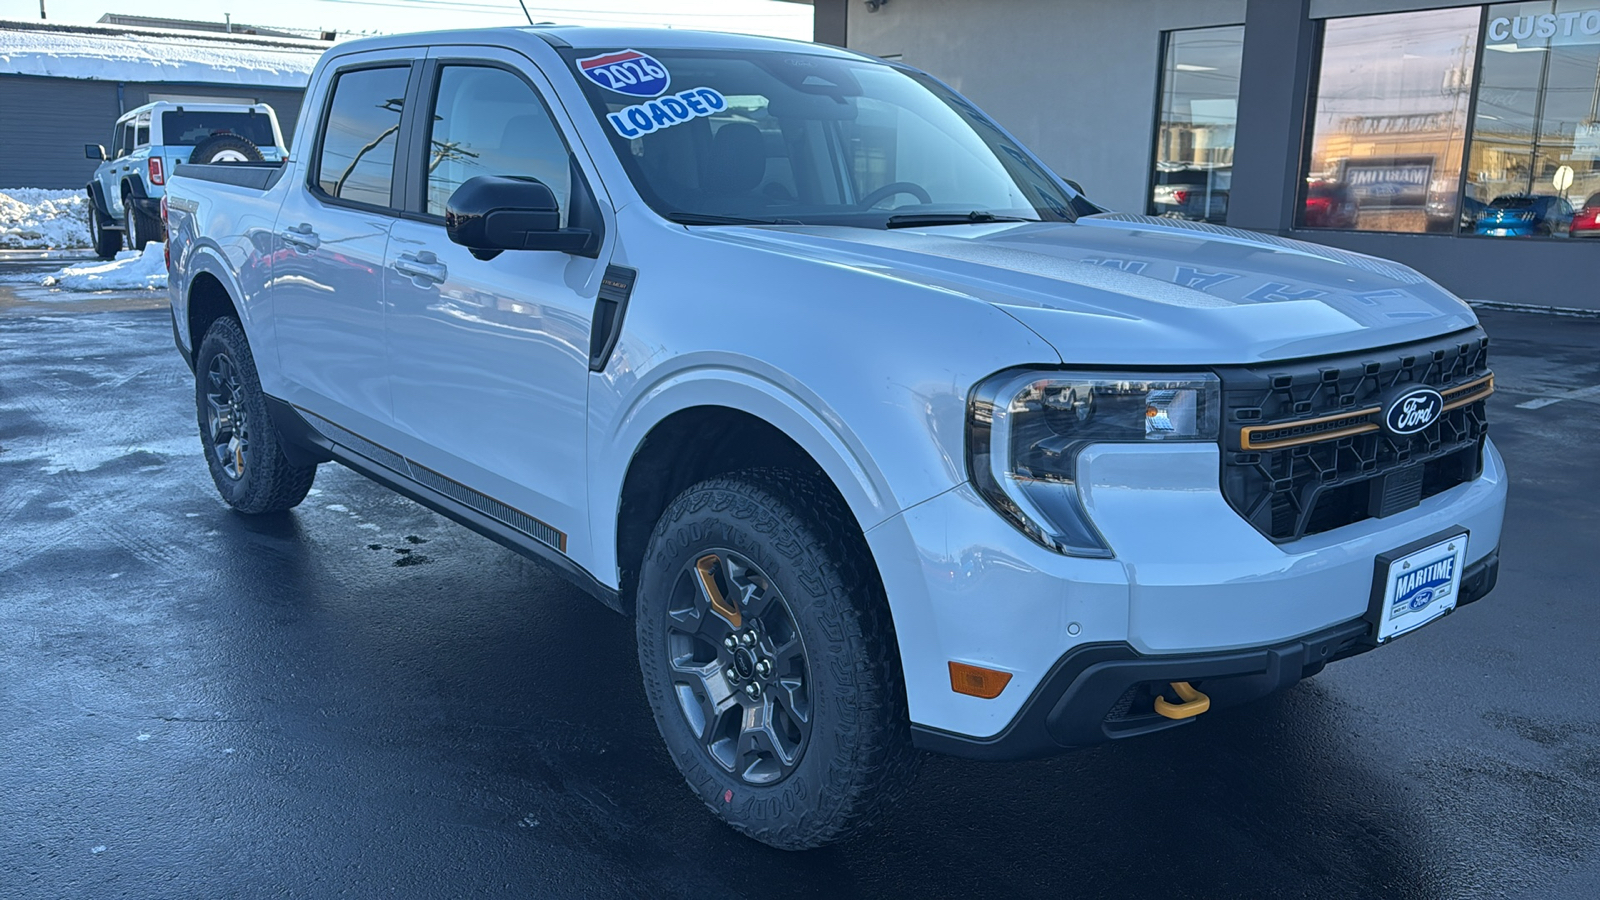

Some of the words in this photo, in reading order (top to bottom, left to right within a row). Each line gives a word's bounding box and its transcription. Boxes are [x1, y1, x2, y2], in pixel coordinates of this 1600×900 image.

[1488, 10, 1600, 41] CUSTO
[593, 58, 665, 89] 2026
[611, 89, 724, 137] LOADED
[1398, 396, 1435, 429] Ford
[656, 517, 780, 578] GOODYEAR
[1395, 557, 1454, 602] MARITIME
[1413, 592, 1431, 608] Ford
